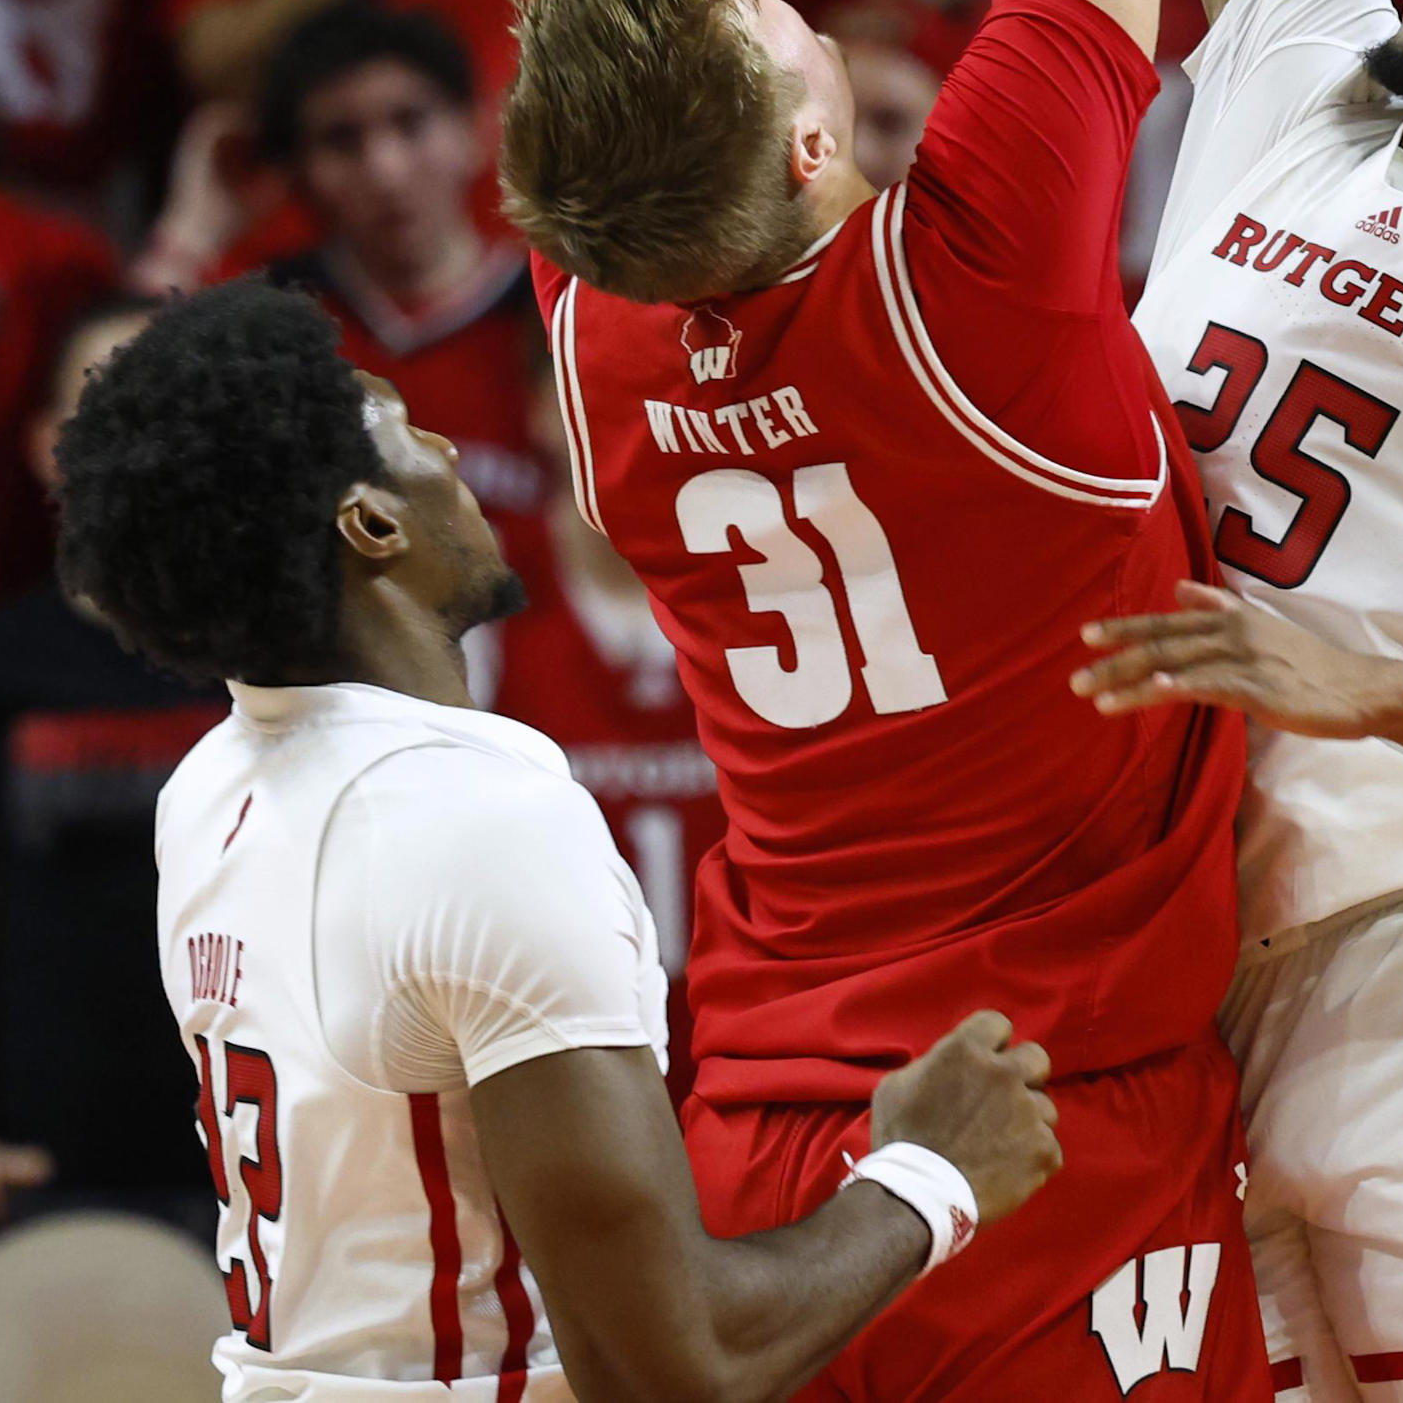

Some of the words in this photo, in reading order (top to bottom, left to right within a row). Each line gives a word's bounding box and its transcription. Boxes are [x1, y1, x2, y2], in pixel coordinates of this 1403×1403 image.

[1355, 220, 1400, 244] adidas
[644, 385, 820, 455] WINTER
[690, 346, 730, 385] W
[1173, 320, 1401, 589] 25
[675, 462, 949, 729] 31
[1089, 1242, 1222, 1397] W
